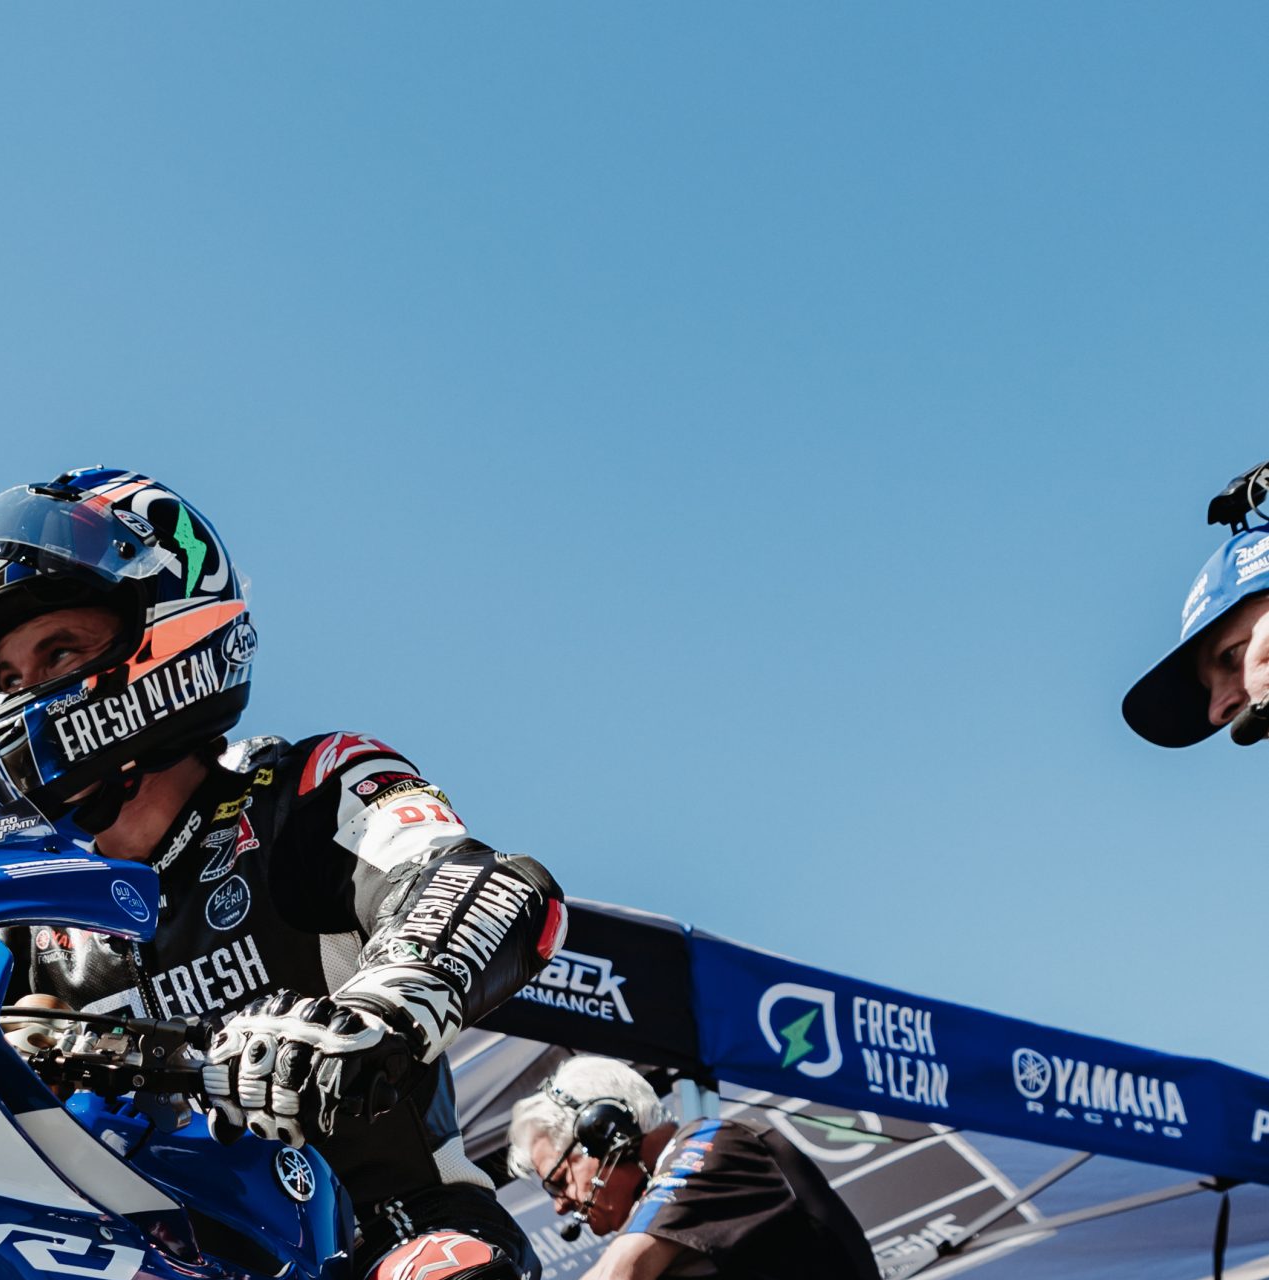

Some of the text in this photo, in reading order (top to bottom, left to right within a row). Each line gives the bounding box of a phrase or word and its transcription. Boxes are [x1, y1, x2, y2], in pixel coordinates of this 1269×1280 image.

[55, 648, 220, 762] FRESH N LEAN
[152, 810, 202, 874] inestars
[446, 871, 534, 971] YAMAHA
[151, 934, 270, 1021] FRESH
[513, 984, 614, 1020] RMANCE
[531, 948, 634, 1023] ack
[853, 996, 936, 1056] FRESH
[862, 1047, 948, 1108] N LEAN
[1052, 1055, 1188, 1124] YAMAHA
[1026, 1100, 1182, 1138] RACING
